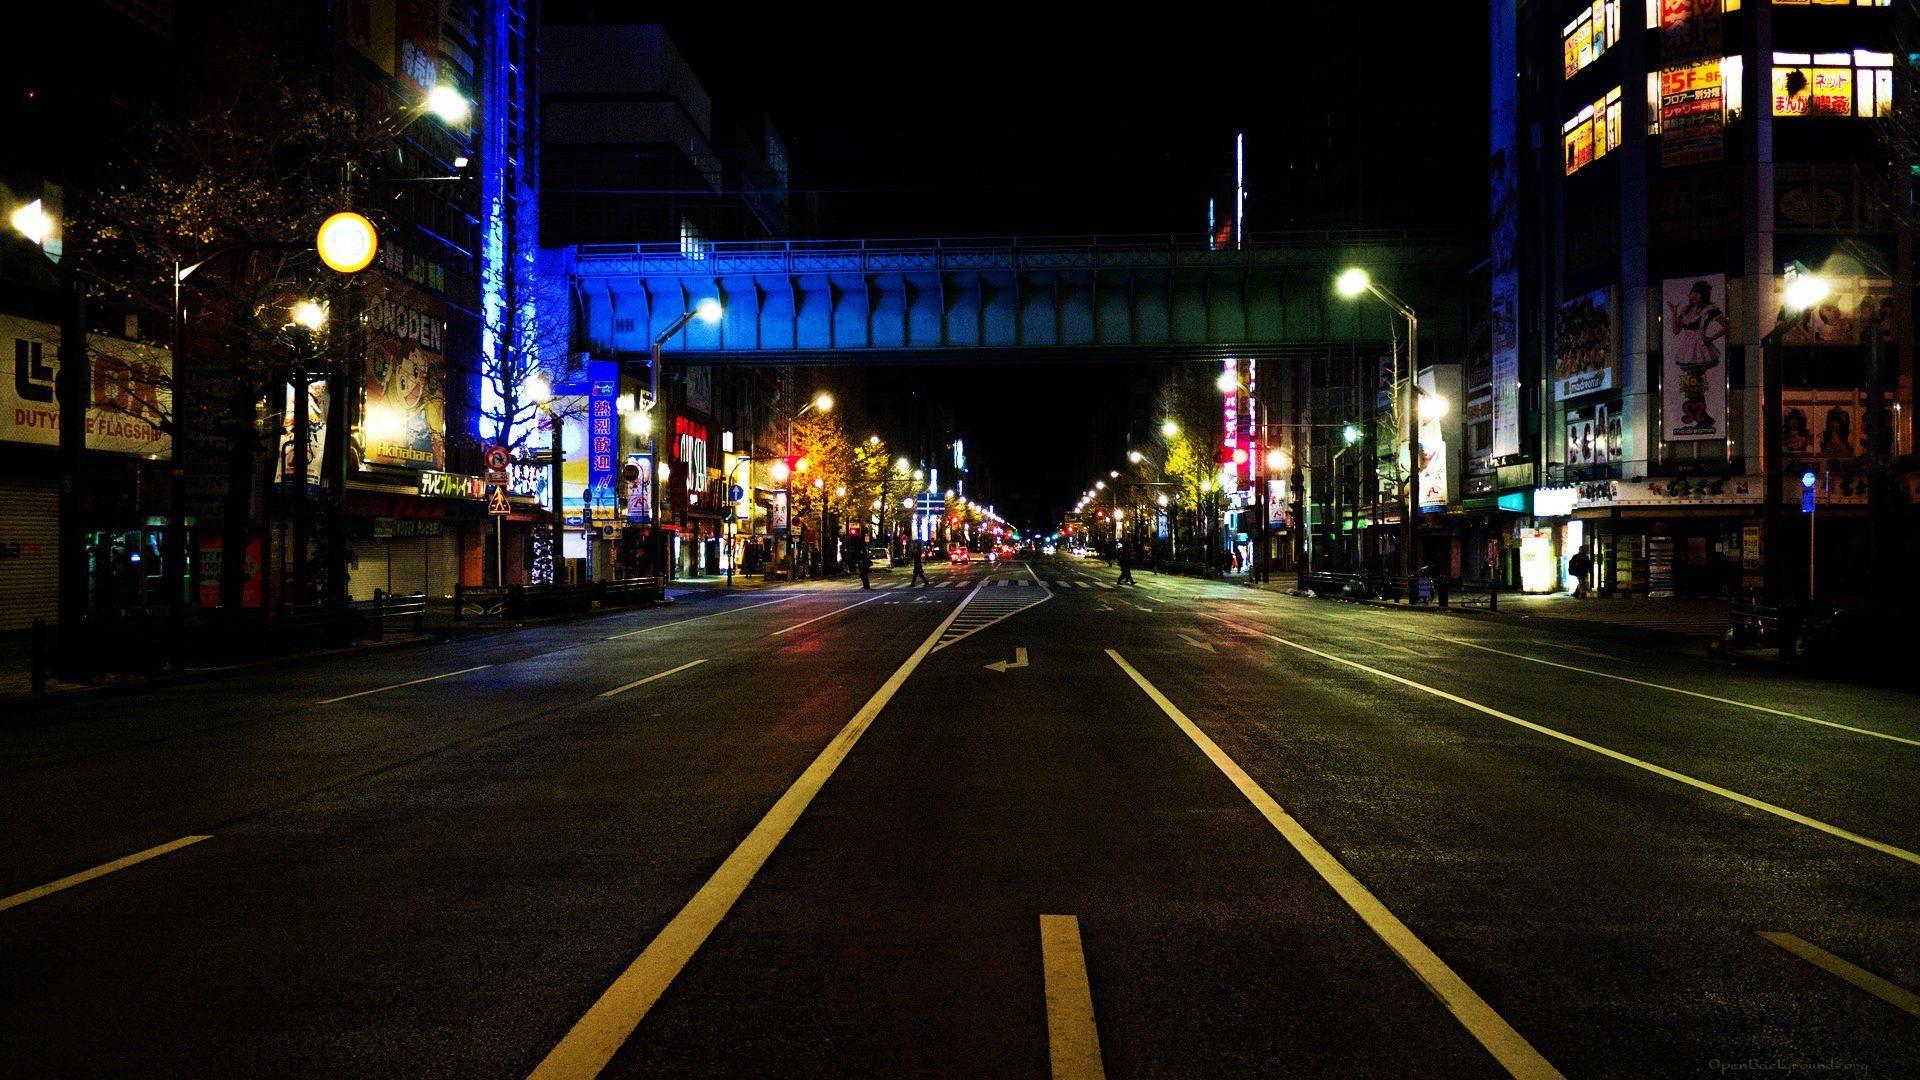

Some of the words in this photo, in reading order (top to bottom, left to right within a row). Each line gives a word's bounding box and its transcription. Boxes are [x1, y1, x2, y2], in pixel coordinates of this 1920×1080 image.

[371, 298, 442, 350] ONODEN
[15, 408, 59, 430] DUTY
[1673, 426, 1716, 436] maidreamin
